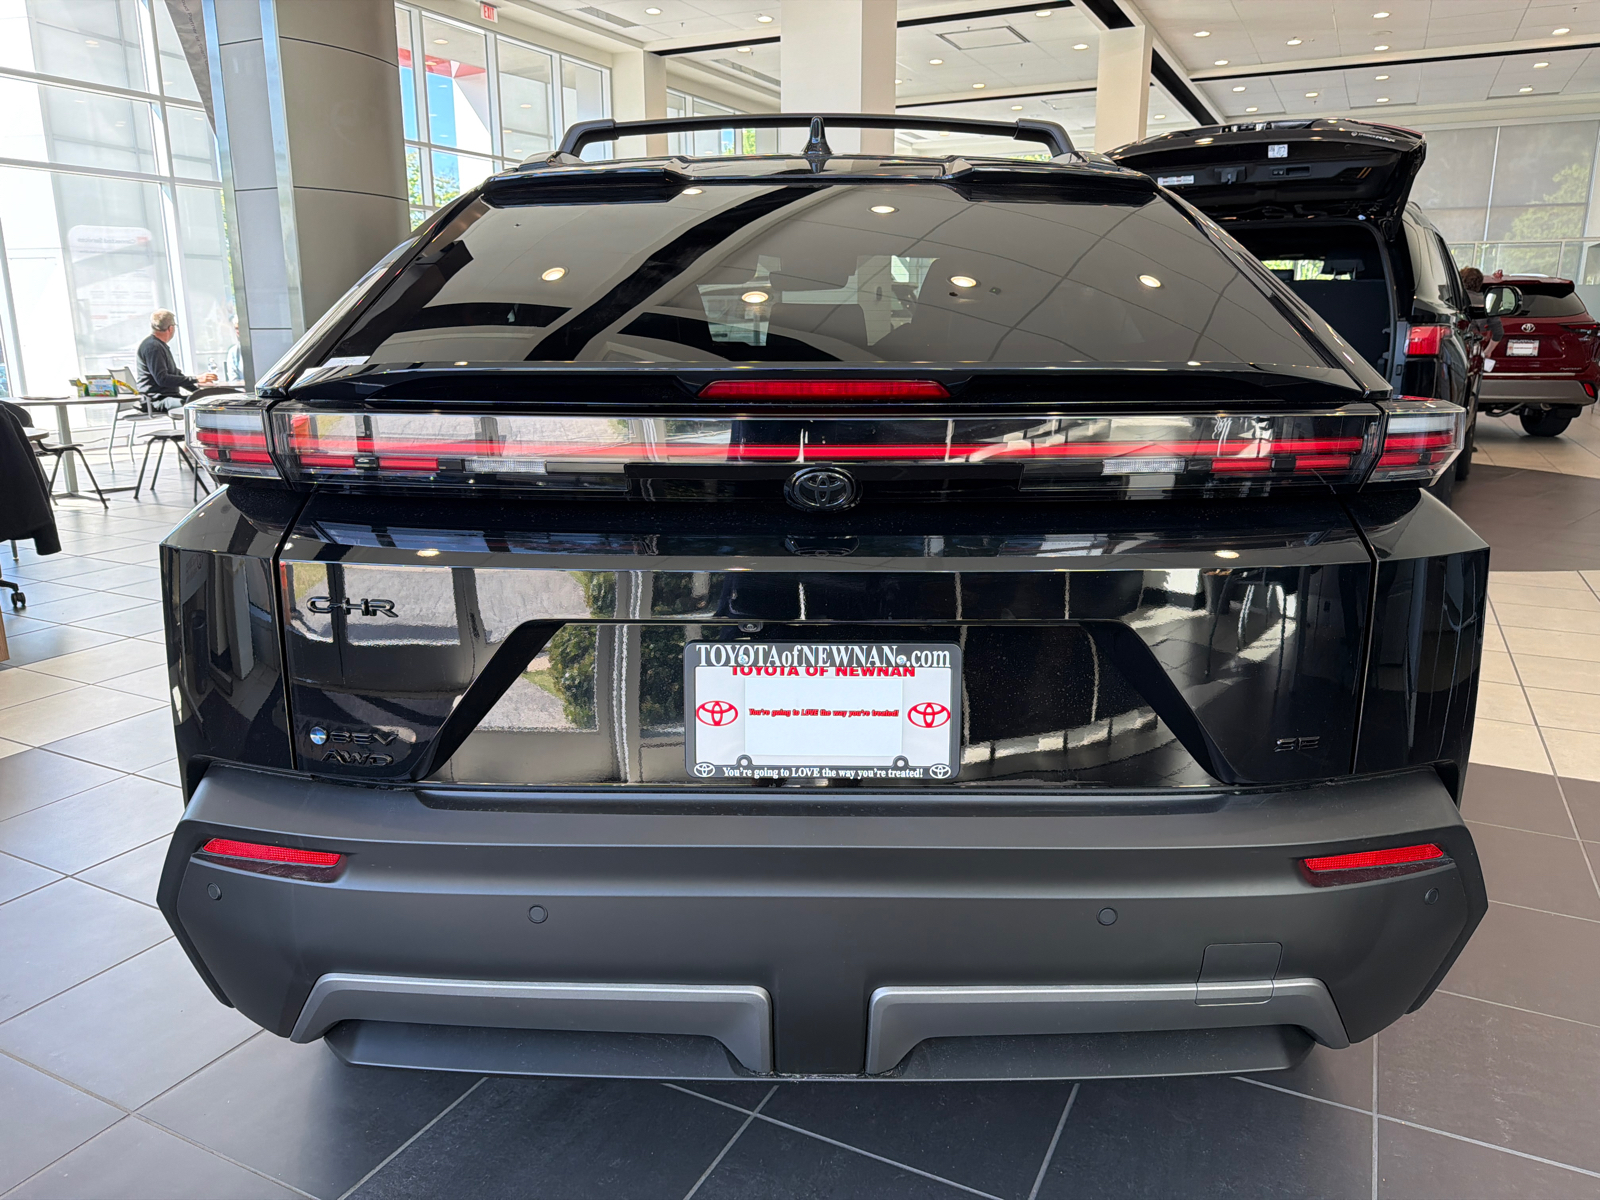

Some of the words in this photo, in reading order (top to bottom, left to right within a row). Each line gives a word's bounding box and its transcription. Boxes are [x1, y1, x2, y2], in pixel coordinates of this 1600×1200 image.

[483, 4, 494, 20] EXIT
[731, 666, 799, 677] TOYOTA
[805, 666, 829, 677] OF
[834, 666, 916, 677] NEWNAN
[771, 708, 791, 718] going
[793, 708, 800, 717] to
[801, 708, 819, 717] LOVE
[820, 708, 831, 717] the
[833, 709, 847, 718] way
[329, 731, 398, 746] BEV
[1274, 736, 1320, 752] SE
[321, 749, 394, 766] AWD
[754, 766, 779, 779] going
[780, 768, 790, 777] to
[791, 767, 820, 777] LOVE
[822, 767, 837, 777] the
[838, 768, 855, 779] way
[887, 767, 924, 778] treated!
